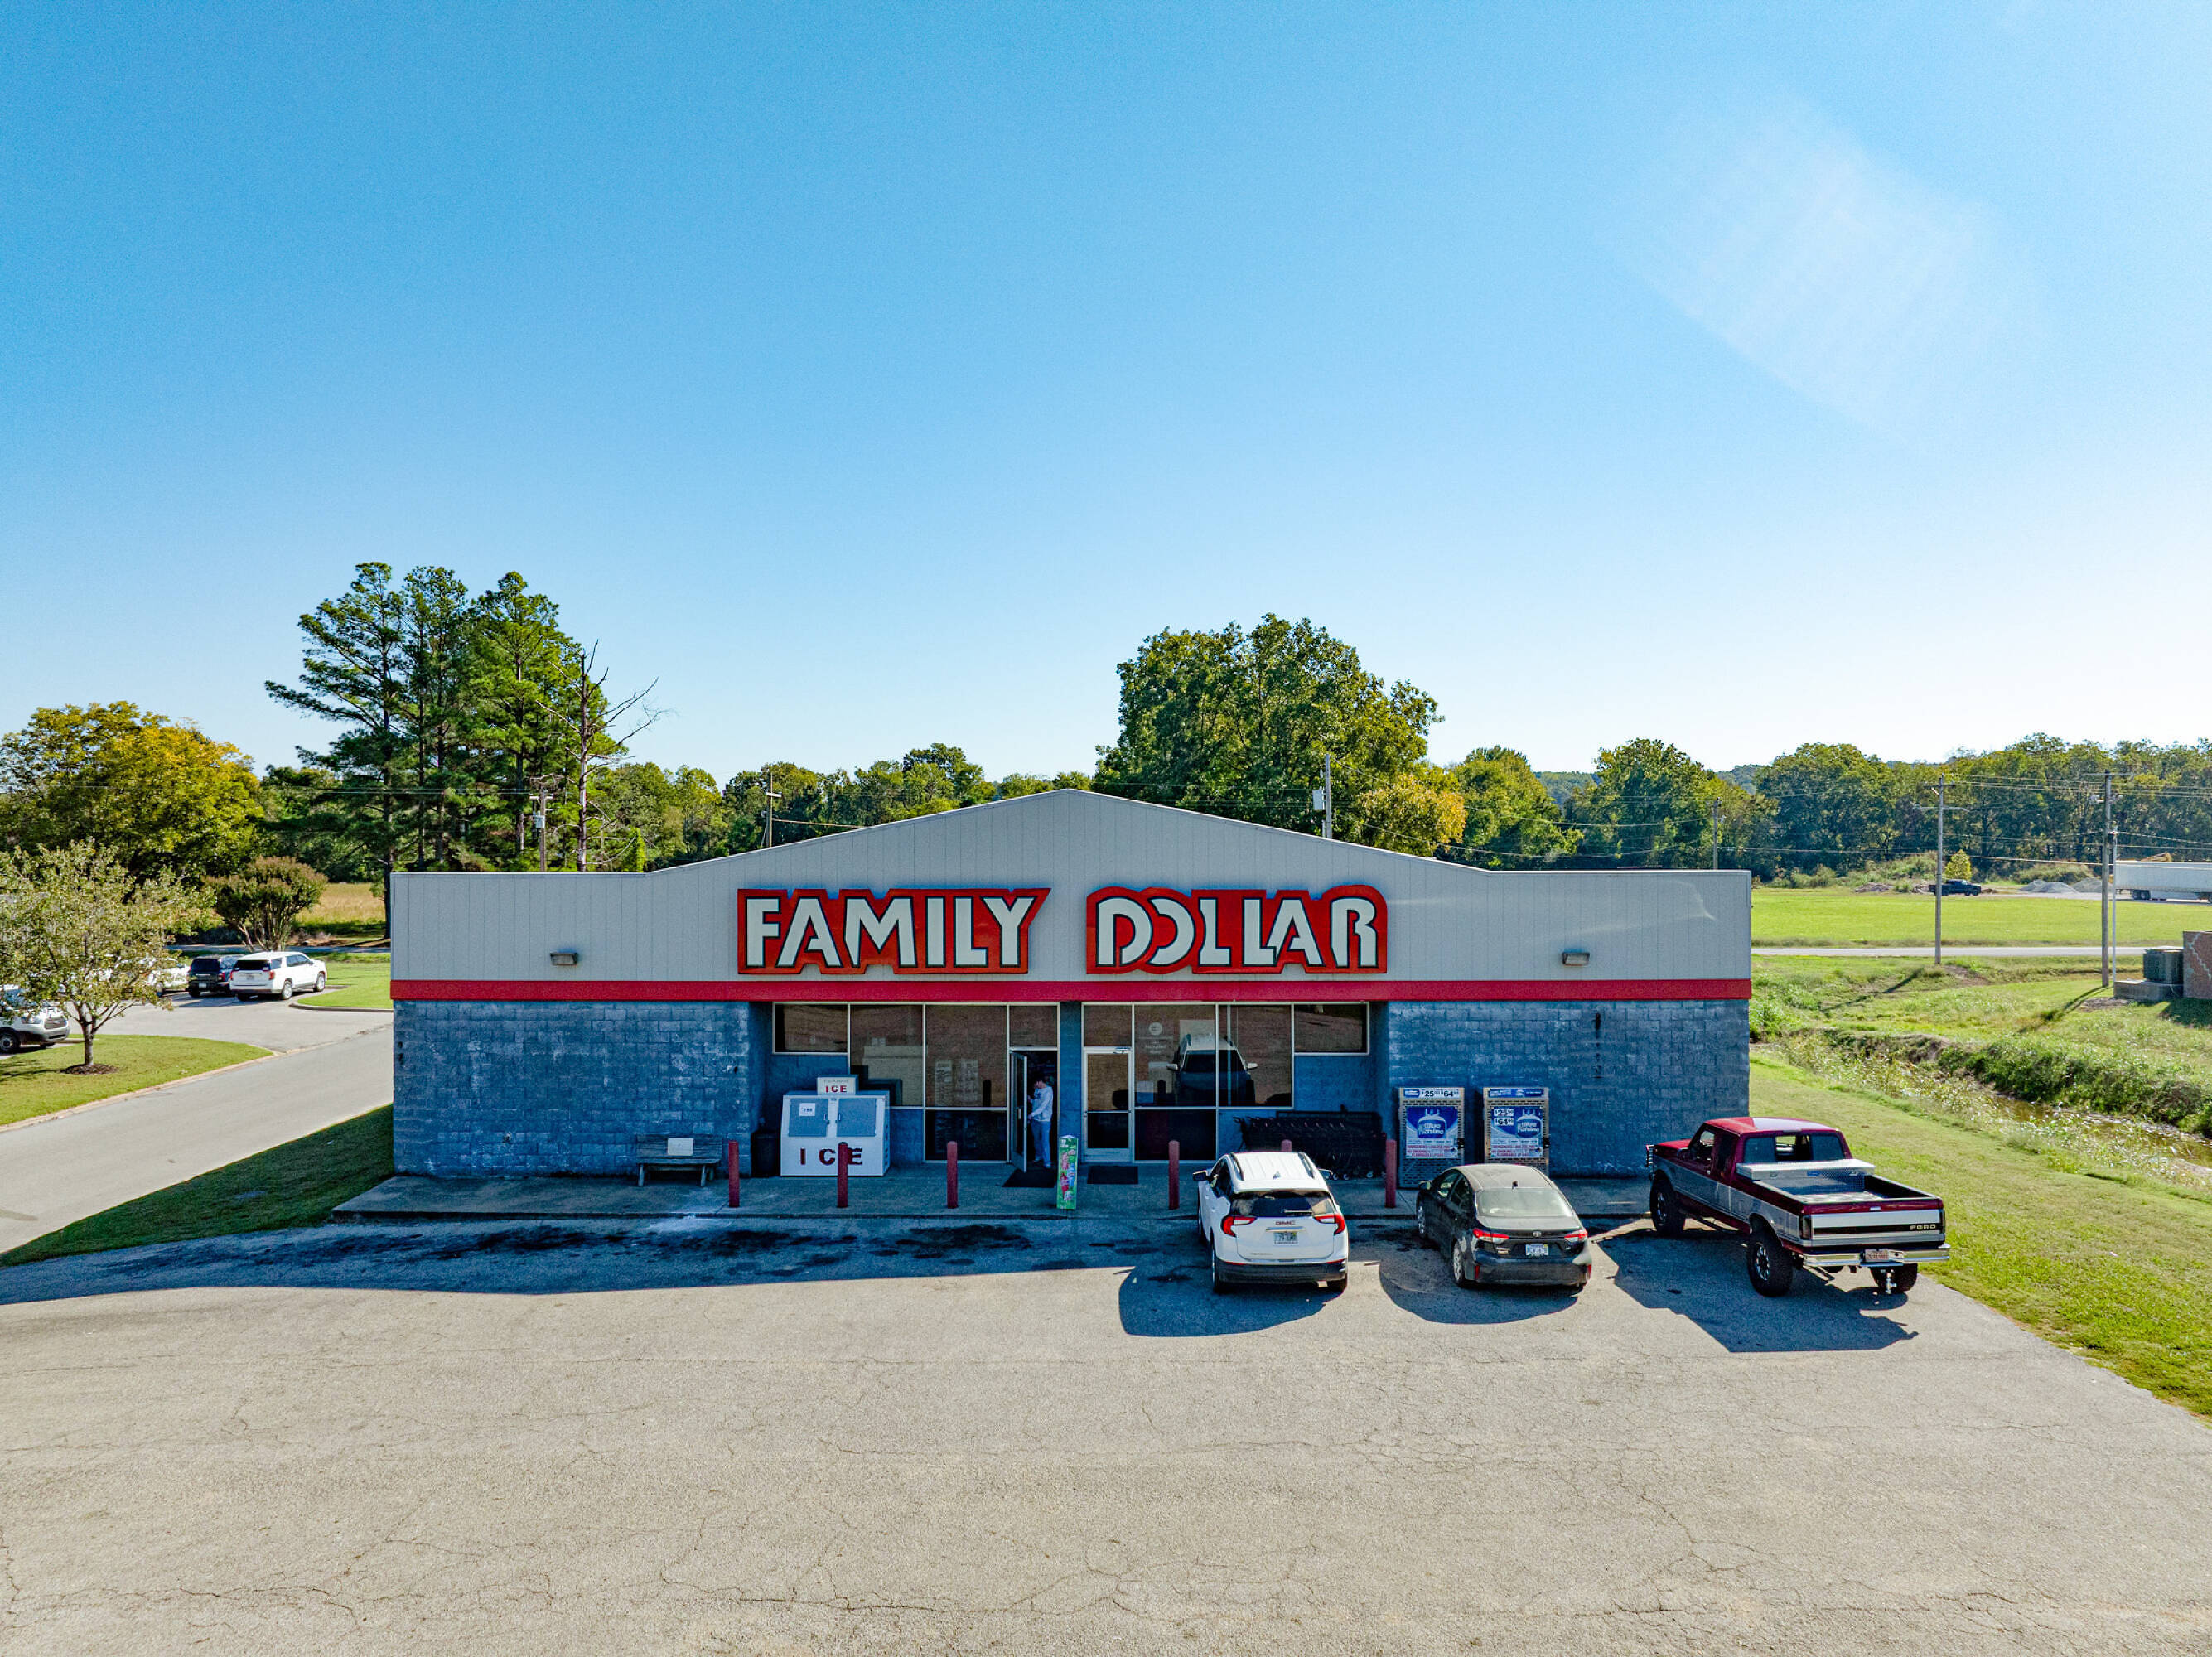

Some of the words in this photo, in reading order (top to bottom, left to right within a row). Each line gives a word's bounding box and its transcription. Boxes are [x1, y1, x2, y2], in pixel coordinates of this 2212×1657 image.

[746, 896, 1037, 968] FAMILY
[1095, 896, 1379, 968] DOLLAR
[825, 1085, 848, 1093] ICE
[800, 1148, 862, 1166] ICE
